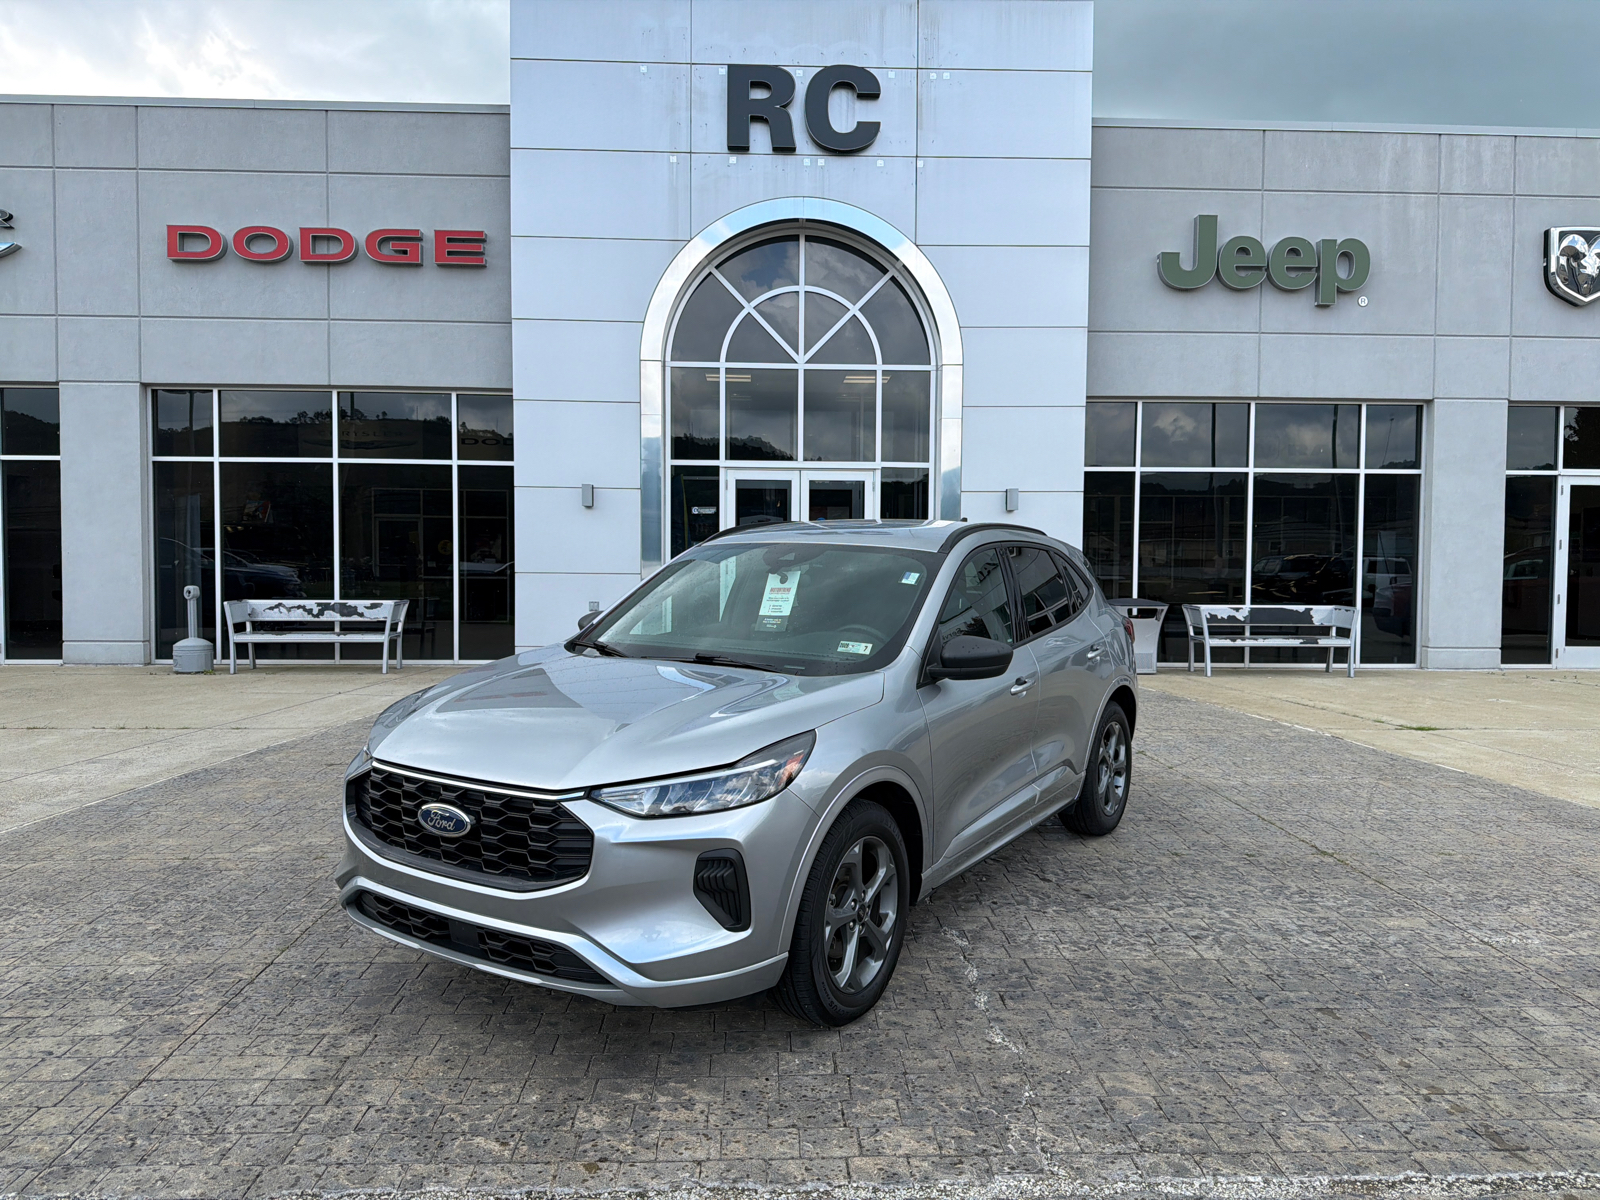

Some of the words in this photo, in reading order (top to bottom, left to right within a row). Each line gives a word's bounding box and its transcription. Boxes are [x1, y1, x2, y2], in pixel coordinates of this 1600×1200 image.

[727, 64, 881, 154] RC
[166, 224, 487, 267] DODGE
[1157, 214, 1371, 307] Jeep
[427, 810, 456, 831] Ford
